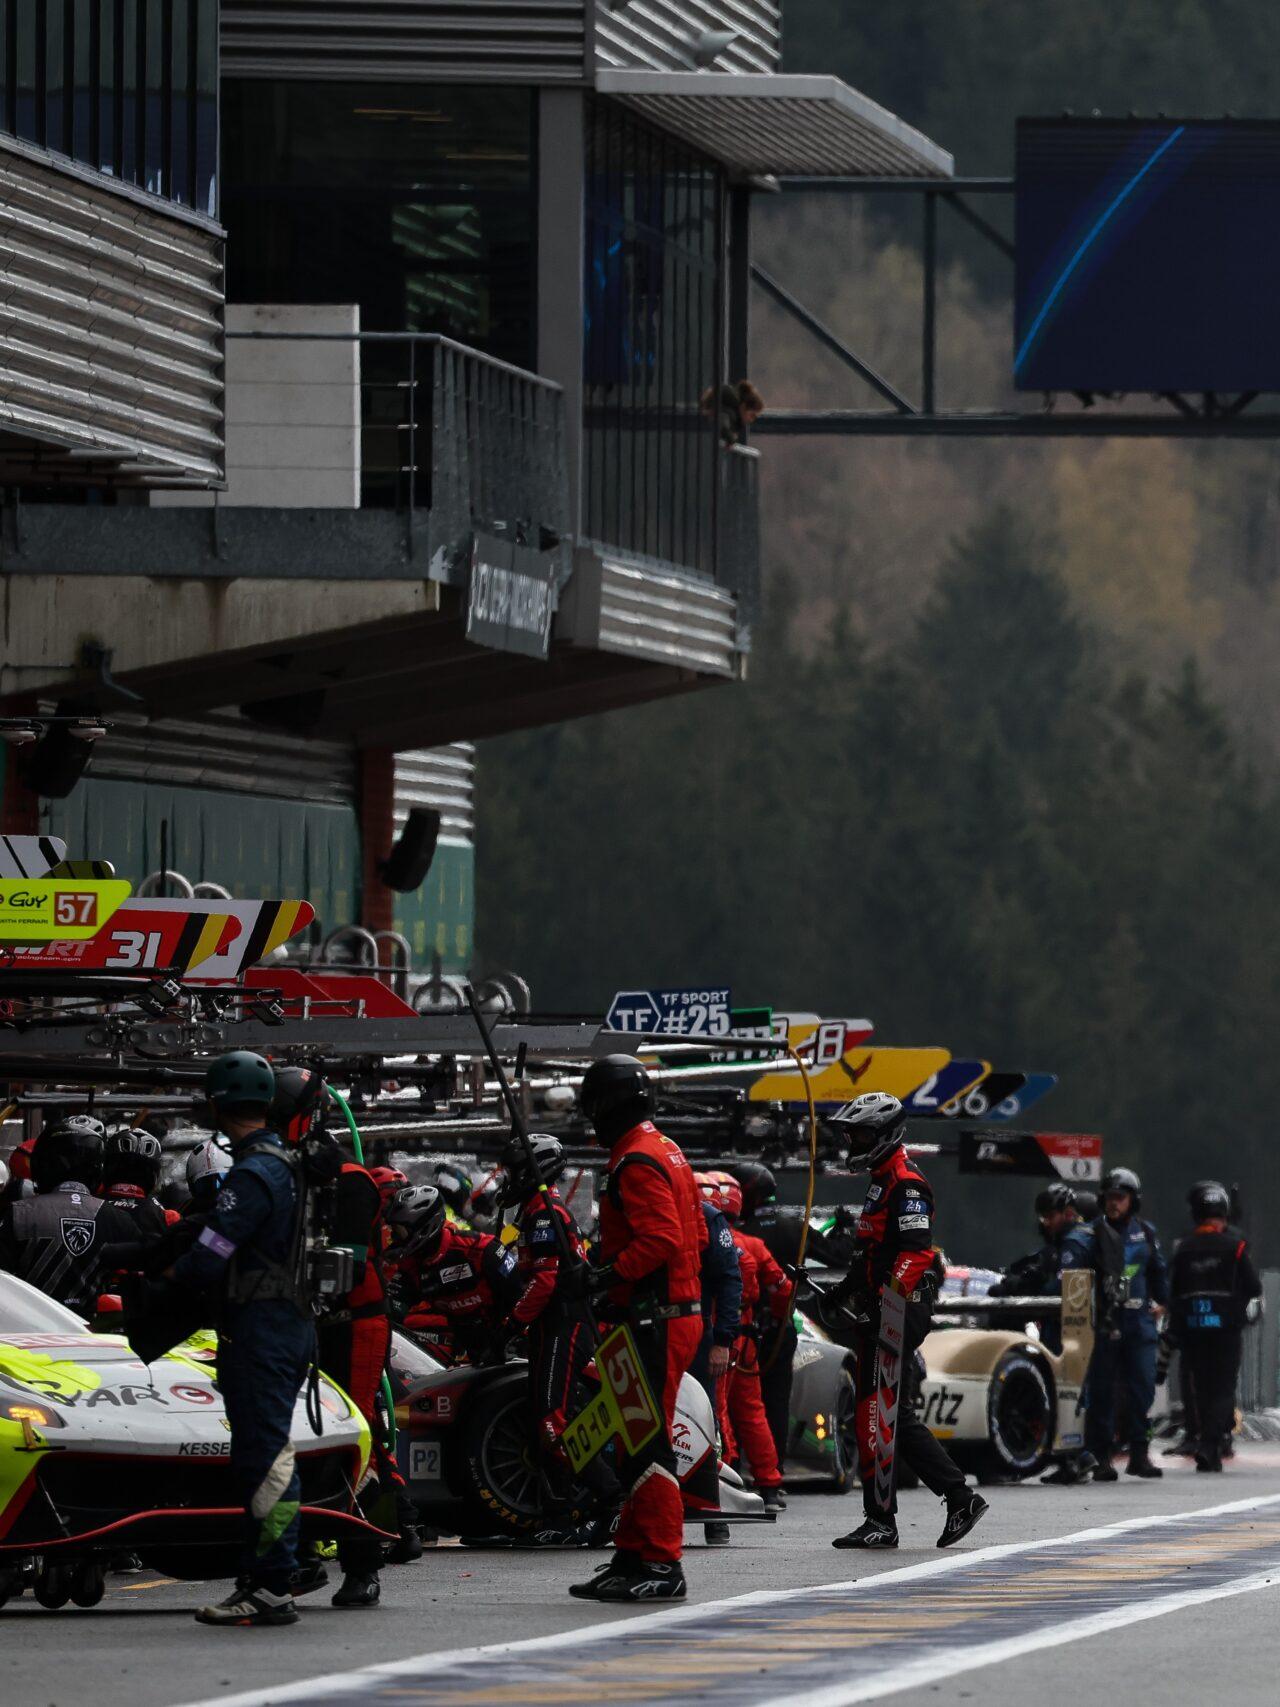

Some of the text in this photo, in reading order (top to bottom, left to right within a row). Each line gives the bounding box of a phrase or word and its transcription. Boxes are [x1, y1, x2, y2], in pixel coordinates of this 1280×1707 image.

[57, 894, 96, 923] 57
[105, 931, 162, 968] 31
[661, 990, 730, 1006] TF SPORT
[616, 1008, 652, 1032] TF
[662, 1004, 730, 1036] #25
[607, 1346, 653, 1422] 57
[869, 1400, 877, 1433] ORLEN
[913, 1386, 963, 1426] ertz
[179, 1442, 230, 1456] KESSE
[413, 1449, 438, 1473] P2
